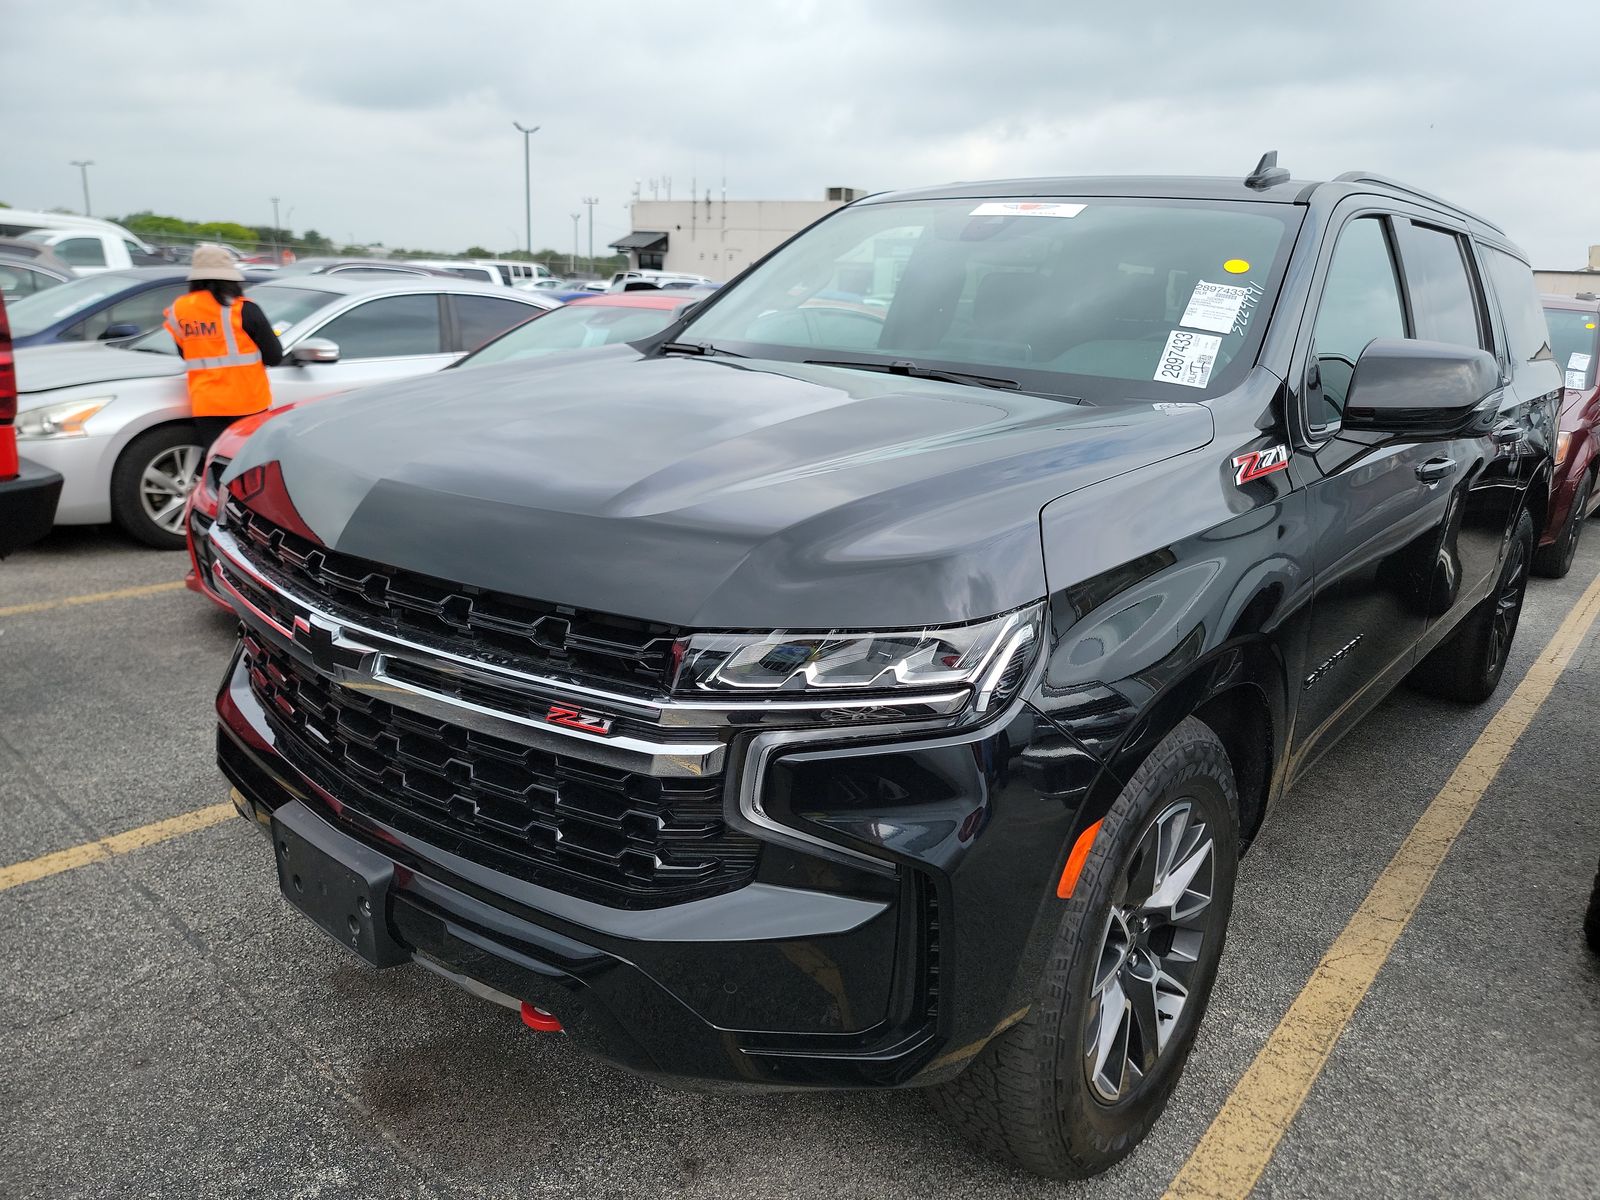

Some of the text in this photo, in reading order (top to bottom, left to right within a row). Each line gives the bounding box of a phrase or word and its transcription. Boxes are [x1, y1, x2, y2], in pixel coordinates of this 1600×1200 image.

[1195, 283, 1245, 297] 2897433
[1161, 332, 1193, 379] 2897433
[1231, 444, 1289, 486] Z71
[545, 706, 612, 735] Z71
